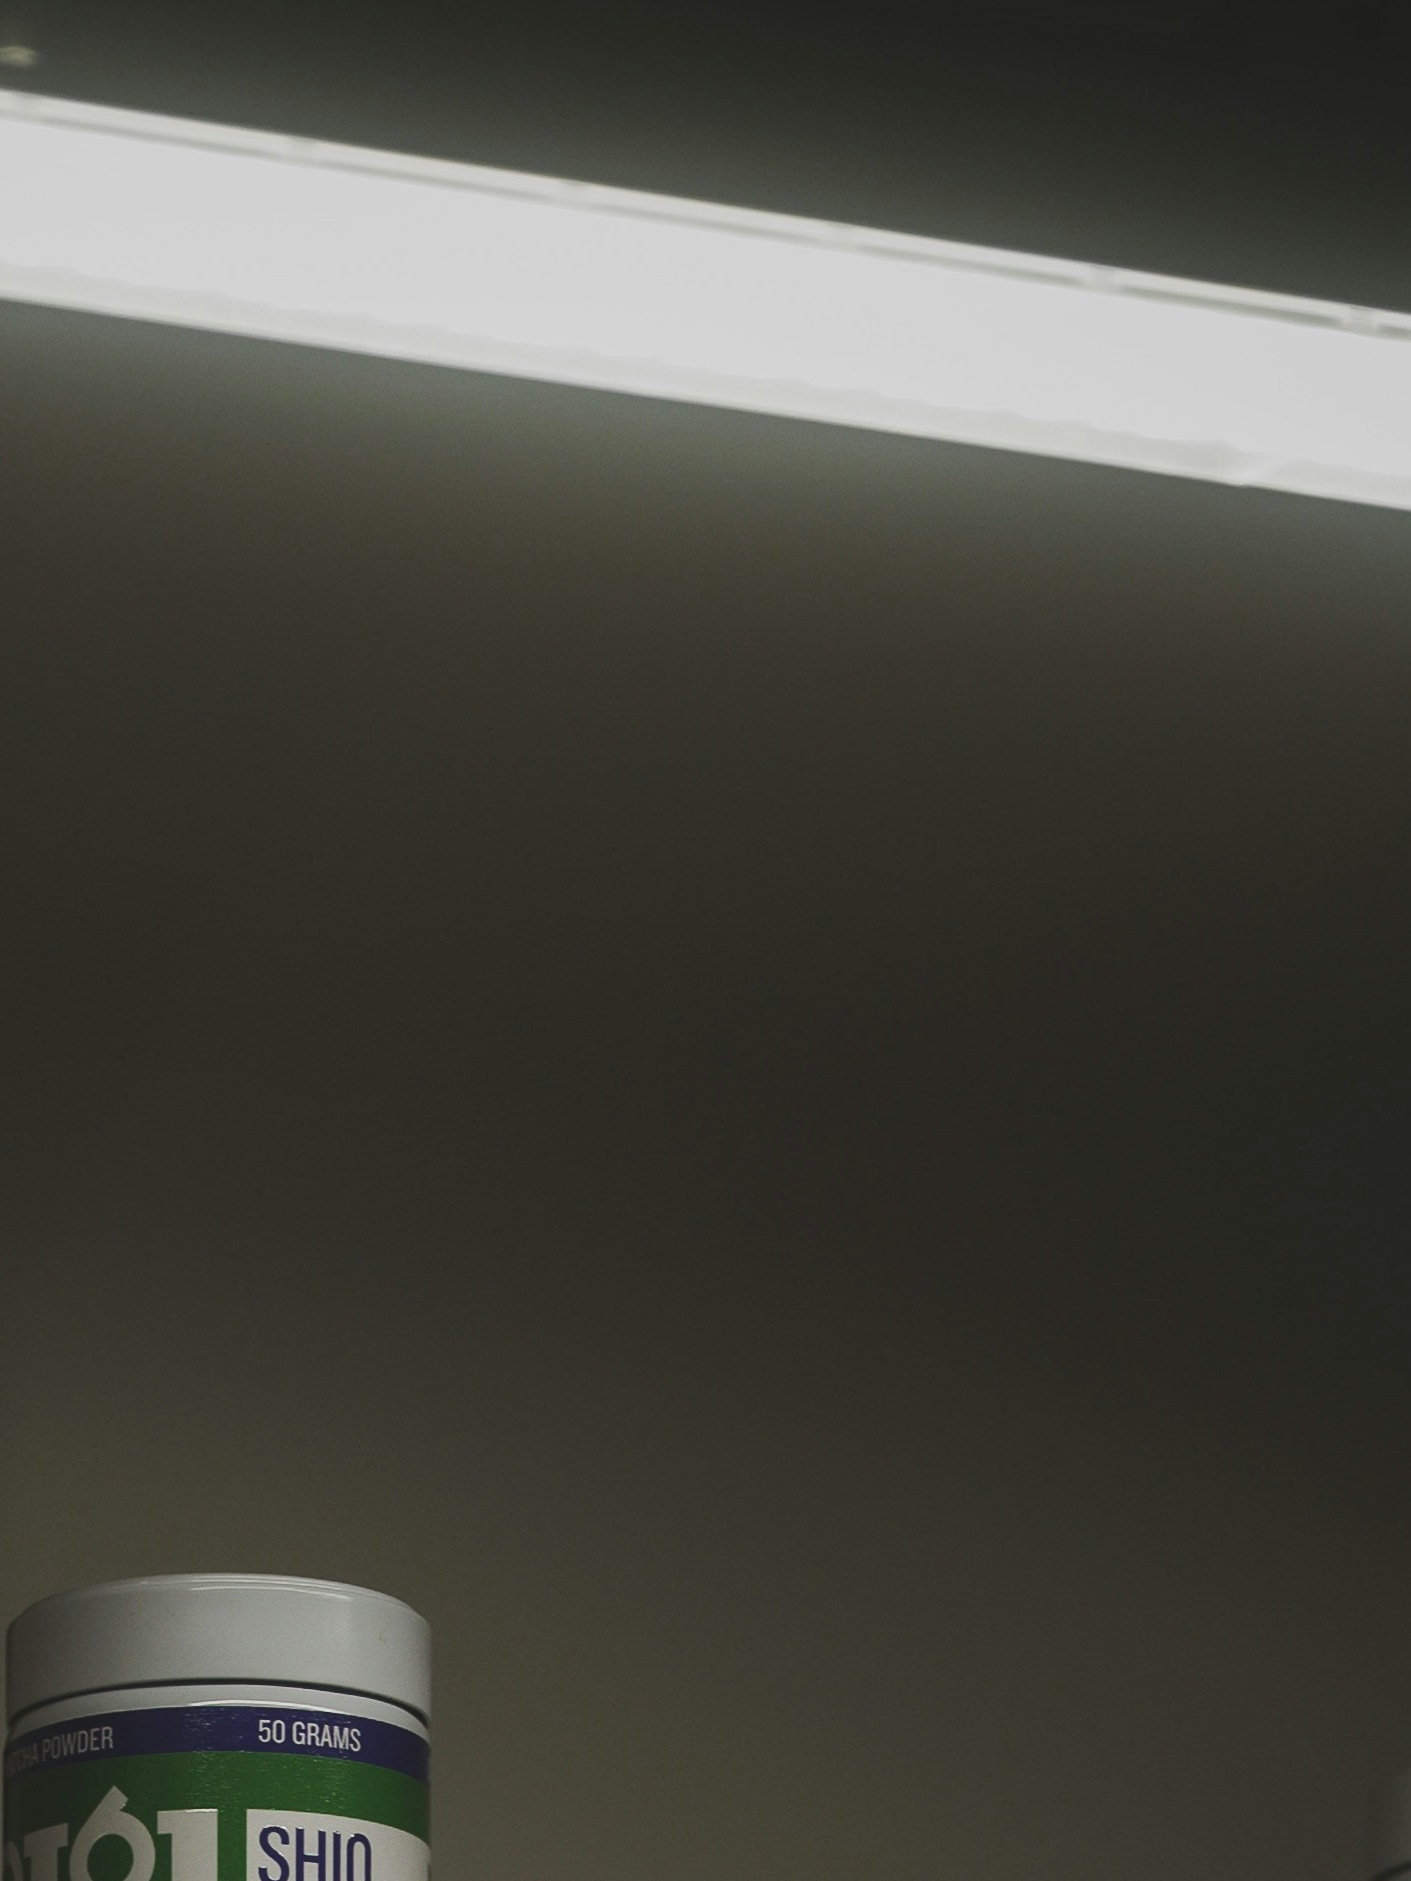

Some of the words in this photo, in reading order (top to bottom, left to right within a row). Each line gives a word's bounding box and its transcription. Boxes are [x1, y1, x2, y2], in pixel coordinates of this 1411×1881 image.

[42, 1725, 114, 1763] POWDER
[258, 1720, 286, 1744] 50
[292, 1721, 361, 1751] GRAMS
